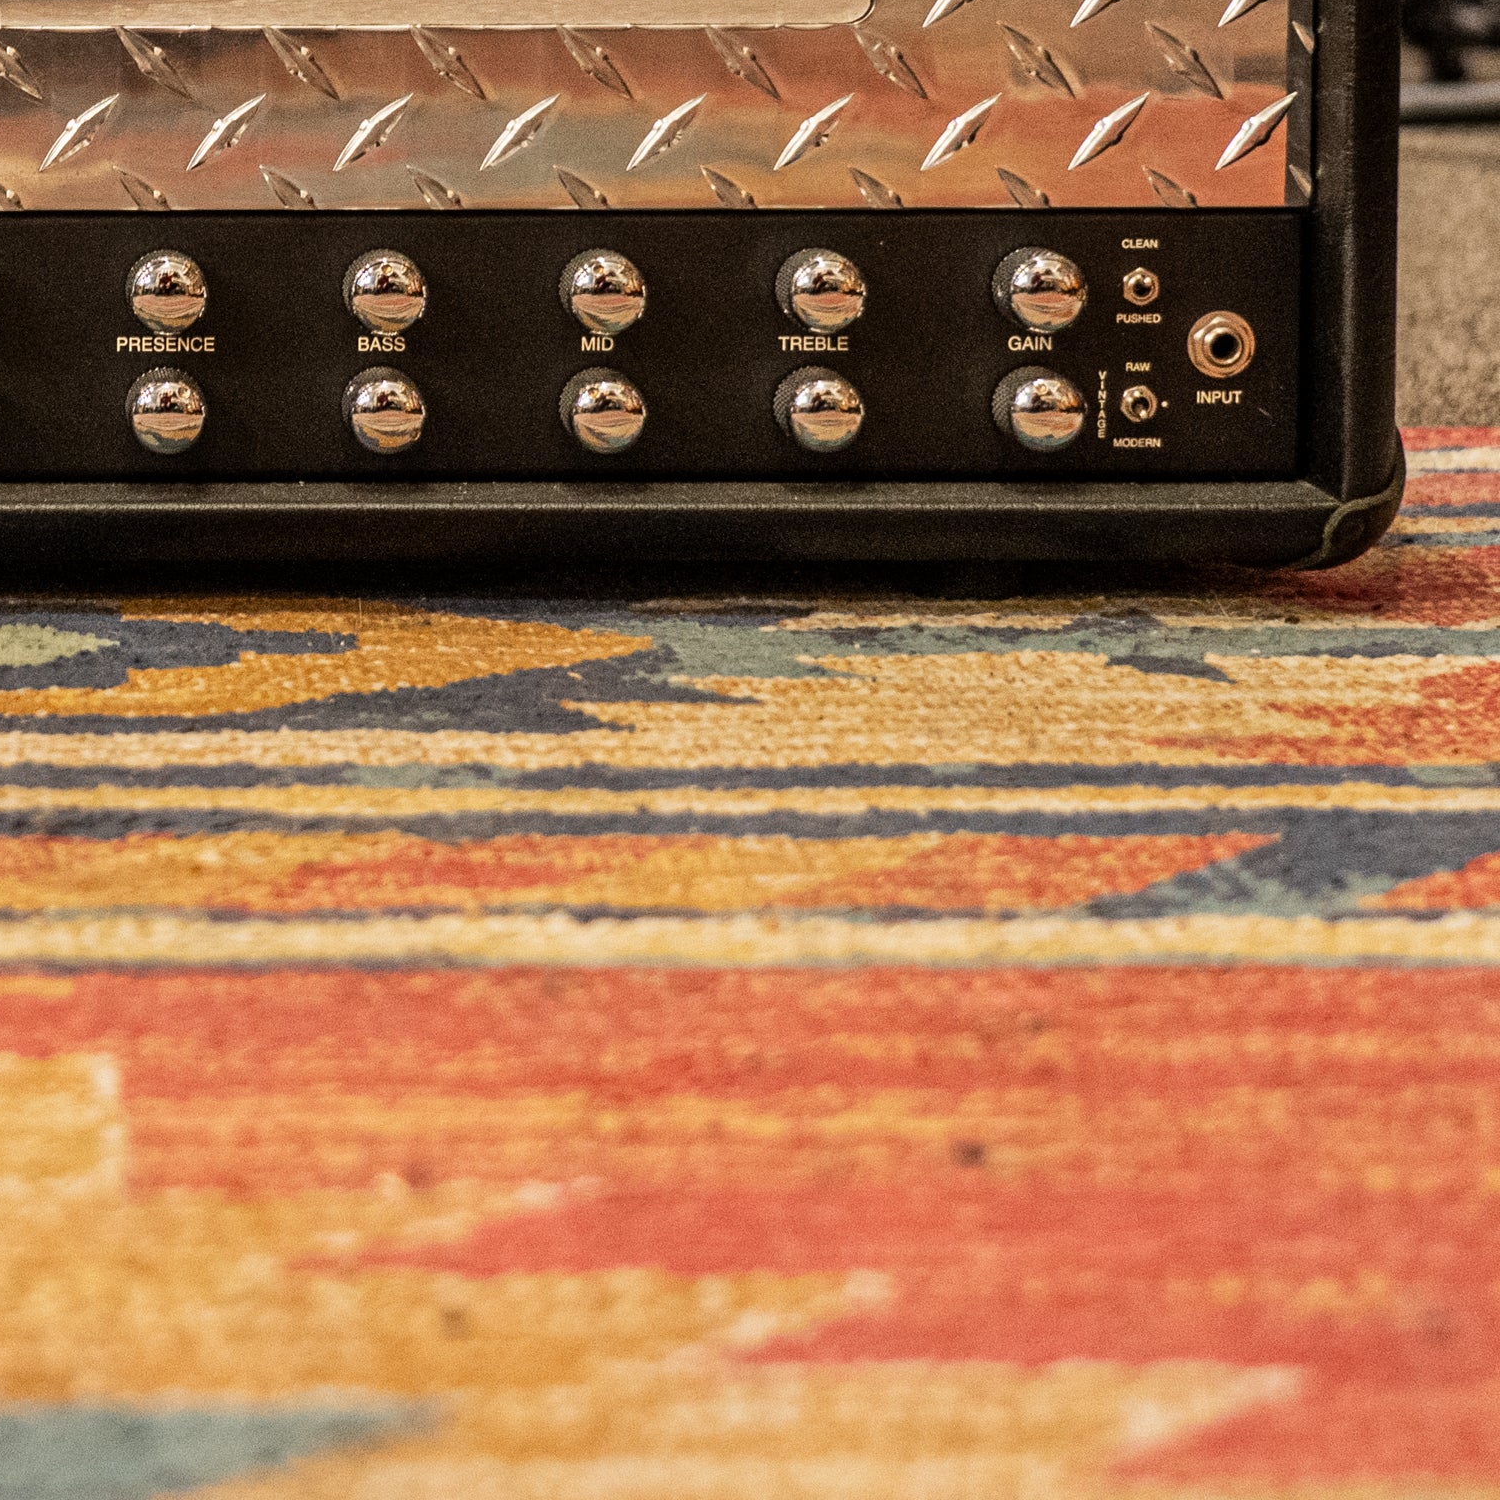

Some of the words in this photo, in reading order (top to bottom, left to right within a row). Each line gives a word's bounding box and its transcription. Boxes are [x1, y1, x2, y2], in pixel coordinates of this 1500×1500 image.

[1121, 238, 1159, 249] CLEAN
[1116, 313, 1162, 324] PUSHED
[116, 337, 215, 353] PRESENCE
[357, 336, 406, 352] BASS
[580, 336, 614, 352] MID
[777, 336, 849, 352] TREBLE
[1007, 335, 1053, 352] GAIN
[1125, 361, 1151, 372] RAW
[1096, 370, 1107, 439] VINTAGE
[1196, 390, 1243, 405] INPUT
[1113, 437, 1161, 448] MODERN
